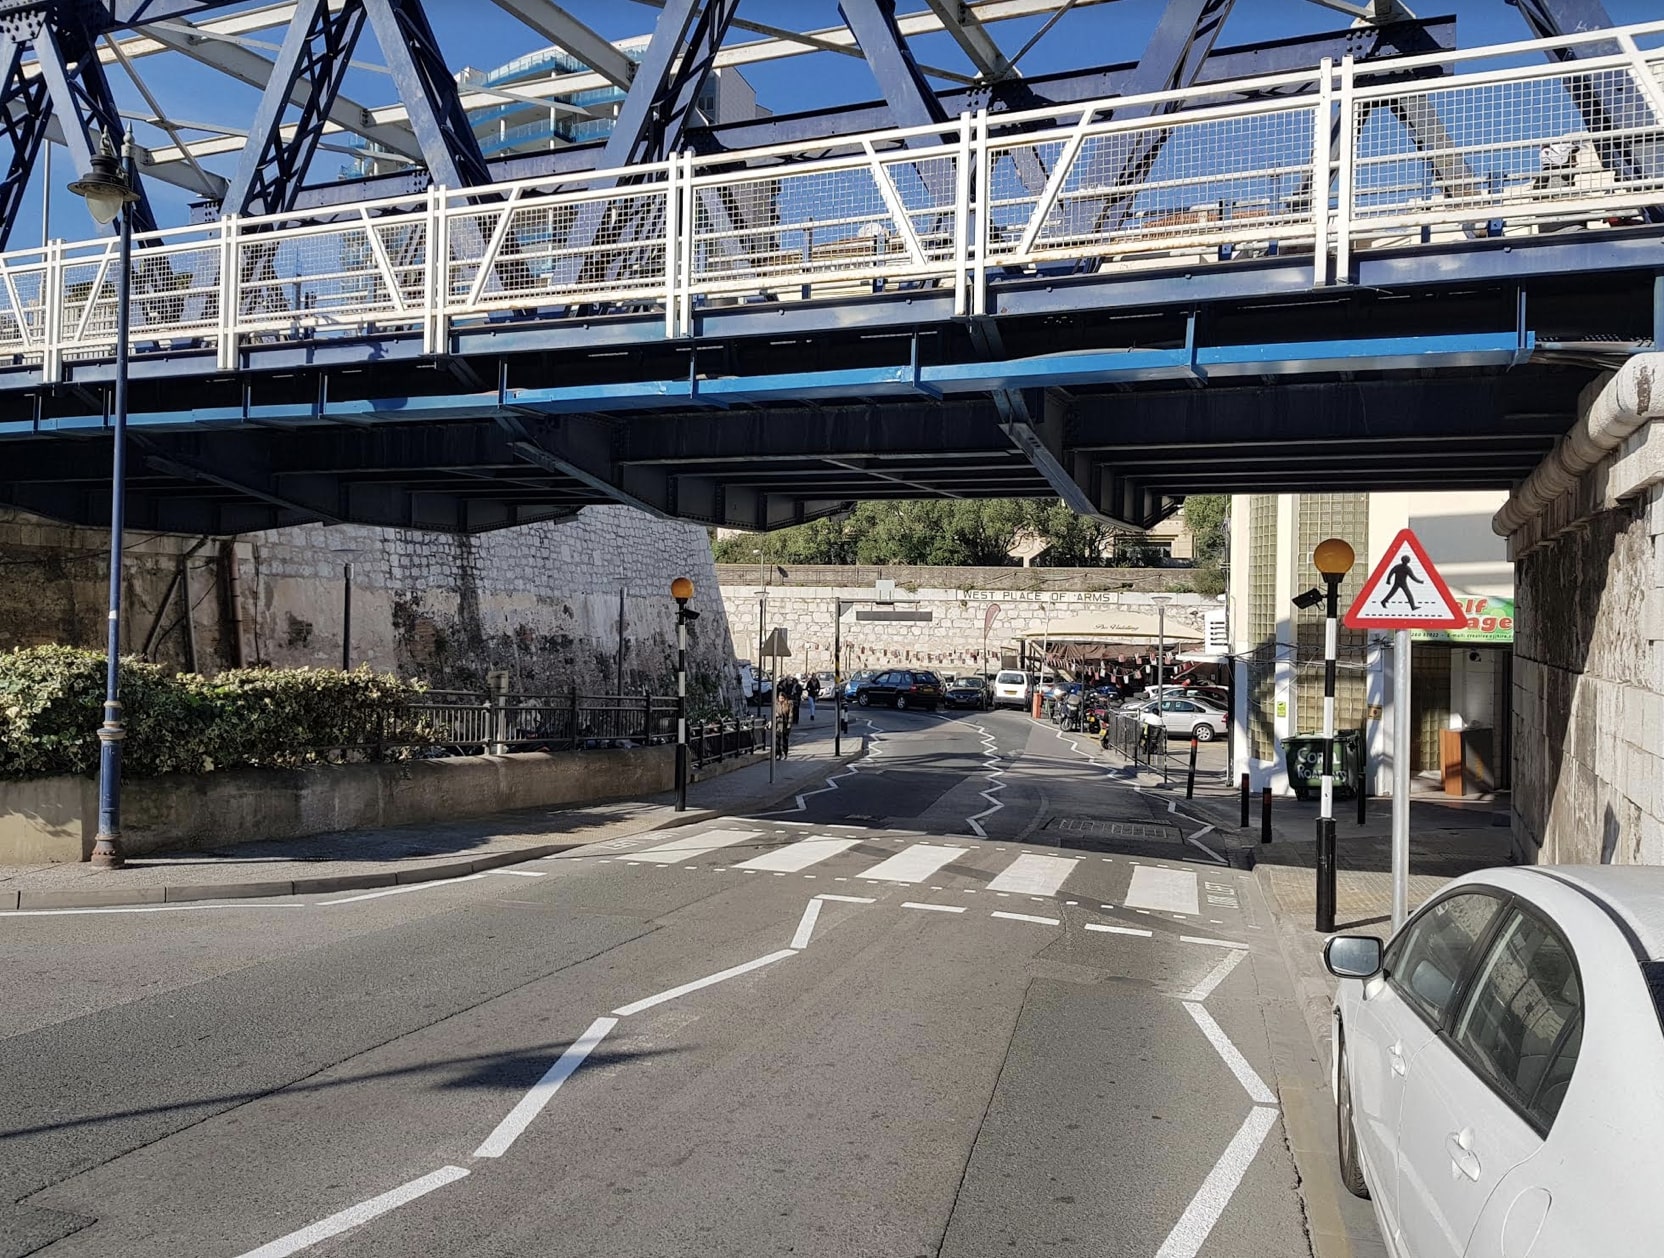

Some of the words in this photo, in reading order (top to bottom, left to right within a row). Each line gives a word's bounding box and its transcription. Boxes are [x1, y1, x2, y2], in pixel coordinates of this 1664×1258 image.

[963, 591, 996, 600] WEST
[1002, 591, 1043, 601] PLACE
[1051, 592, 1066, 601] OF
[1076, 592, 1111, 602] ARMS
[1297, 747, 1341, 764] CORL
